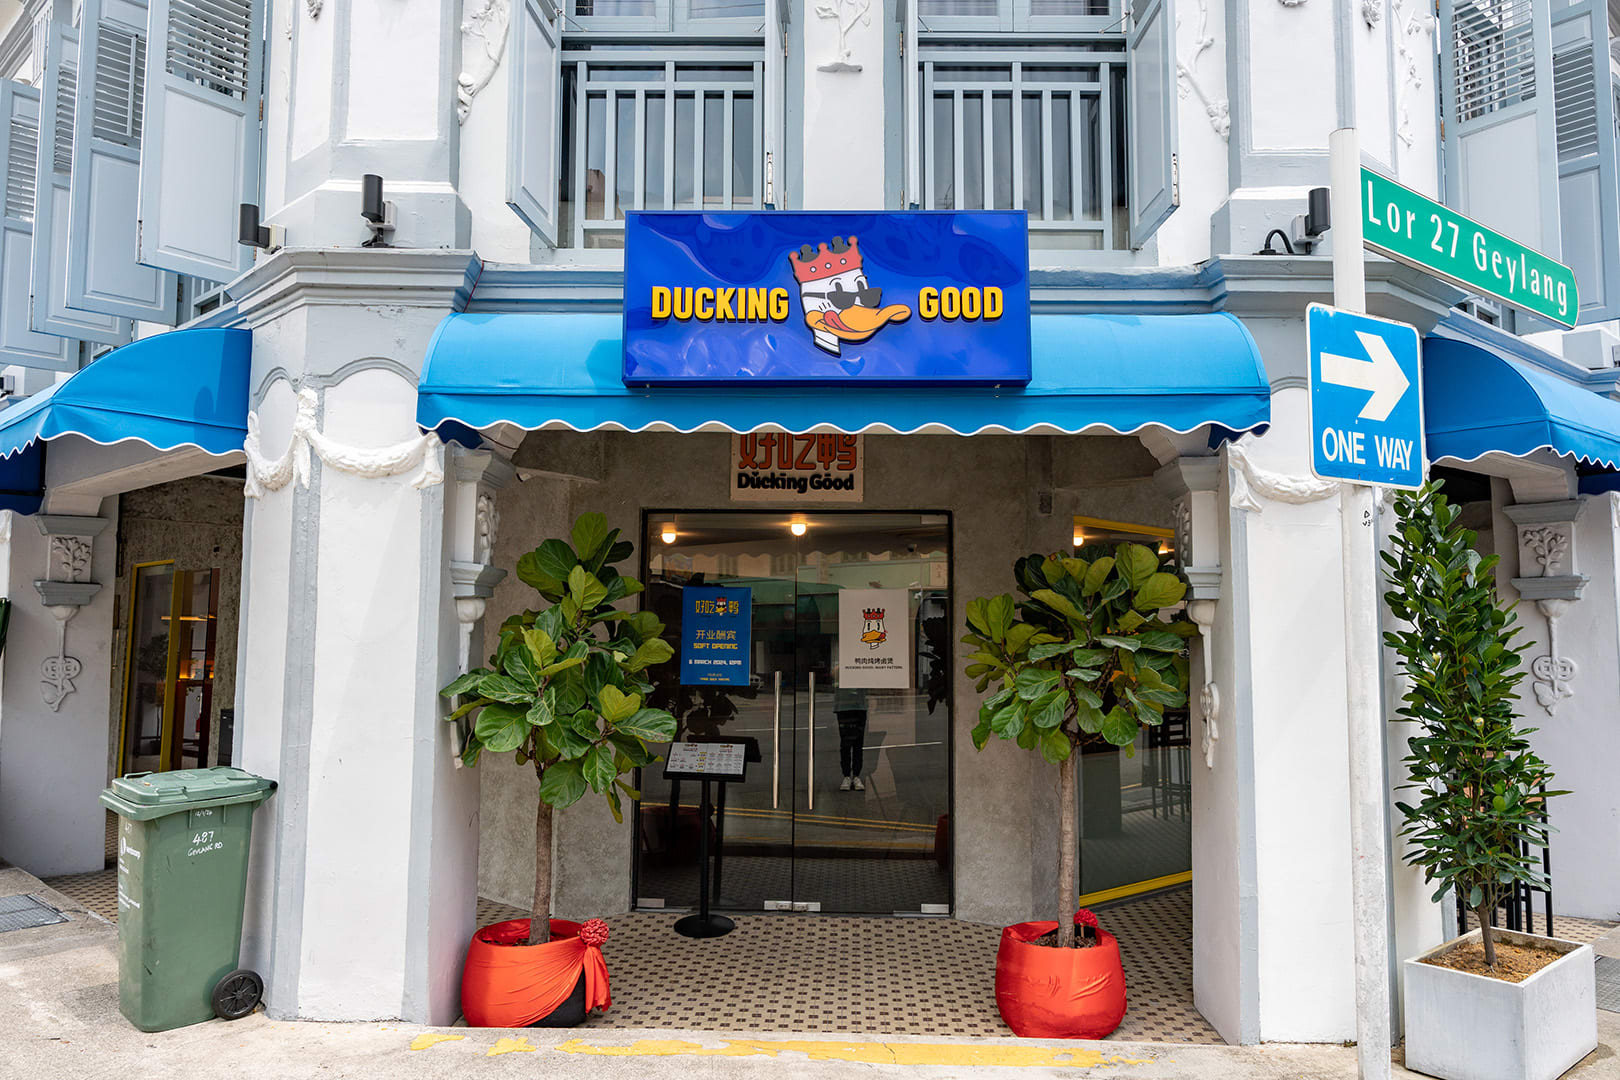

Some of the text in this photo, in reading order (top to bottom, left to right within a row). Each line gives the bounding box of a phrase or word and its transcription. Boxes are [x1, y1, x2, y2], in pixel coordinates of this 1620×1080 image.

[1367, 180, 1568, 317] Lor 27 Geylang
[651, 285, 1004, 323] DUCKING GOOD
[1321, 426, 1414, 472] ONE WAY
[192, 830, 214, 846] 487
